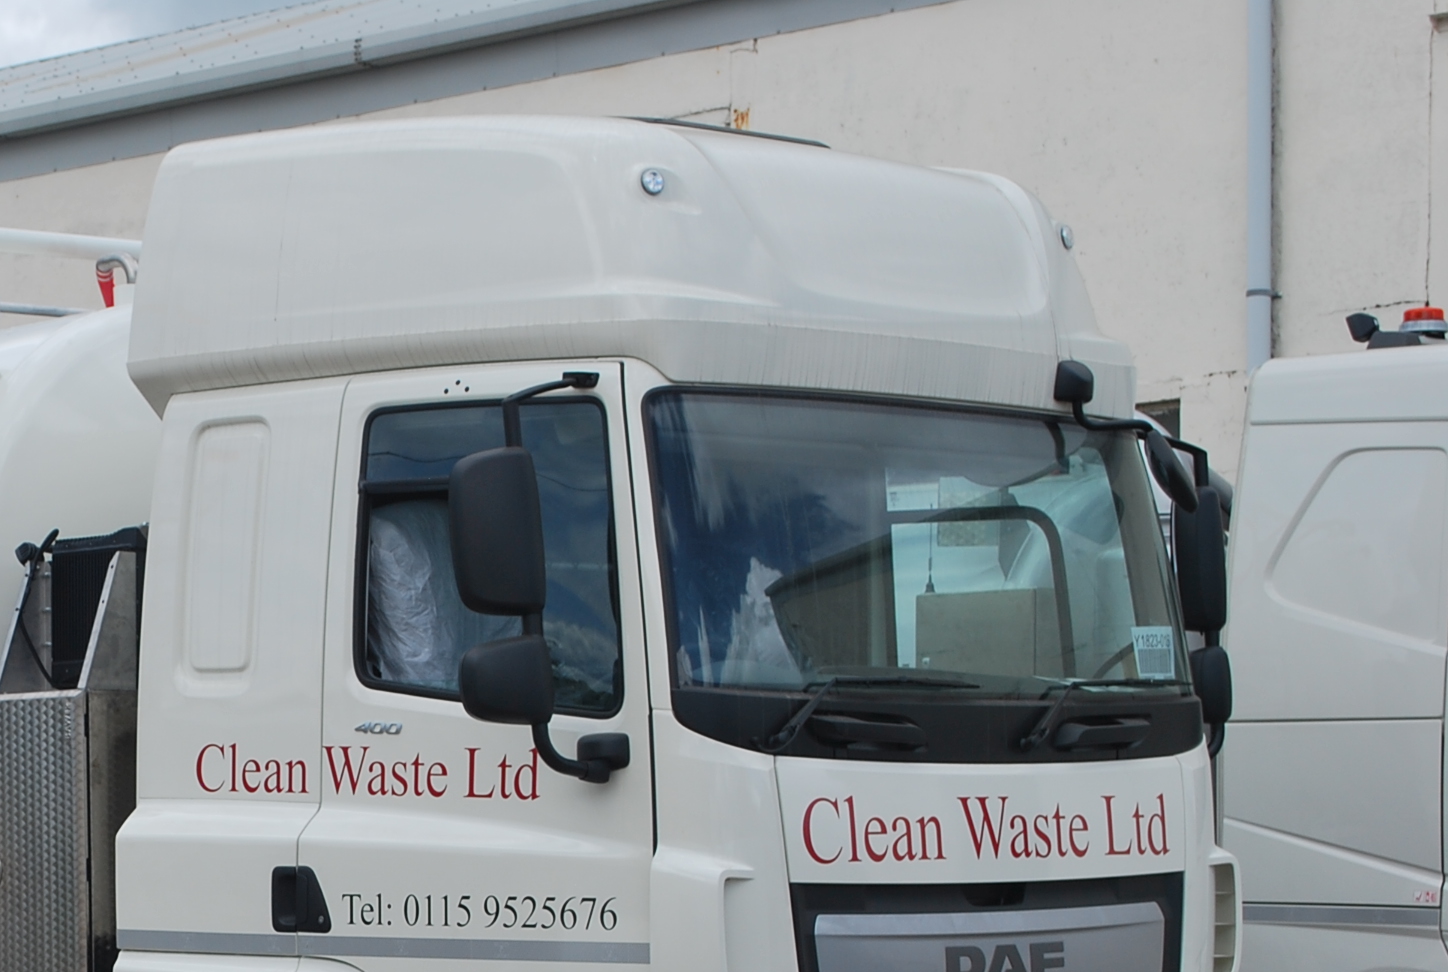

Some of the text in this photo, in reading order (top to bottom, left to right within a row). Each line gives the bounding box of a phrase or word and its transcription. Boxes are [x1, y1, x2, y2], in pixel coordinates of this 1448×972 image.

[354, 720, 403, 735] 400
[195, 743, 541, 801] Clean Waste Ltd
[802, 793, 1170, 865] Clean Waste Ltd
[341, 893, 618, 931] Tel: 0115 9525676
